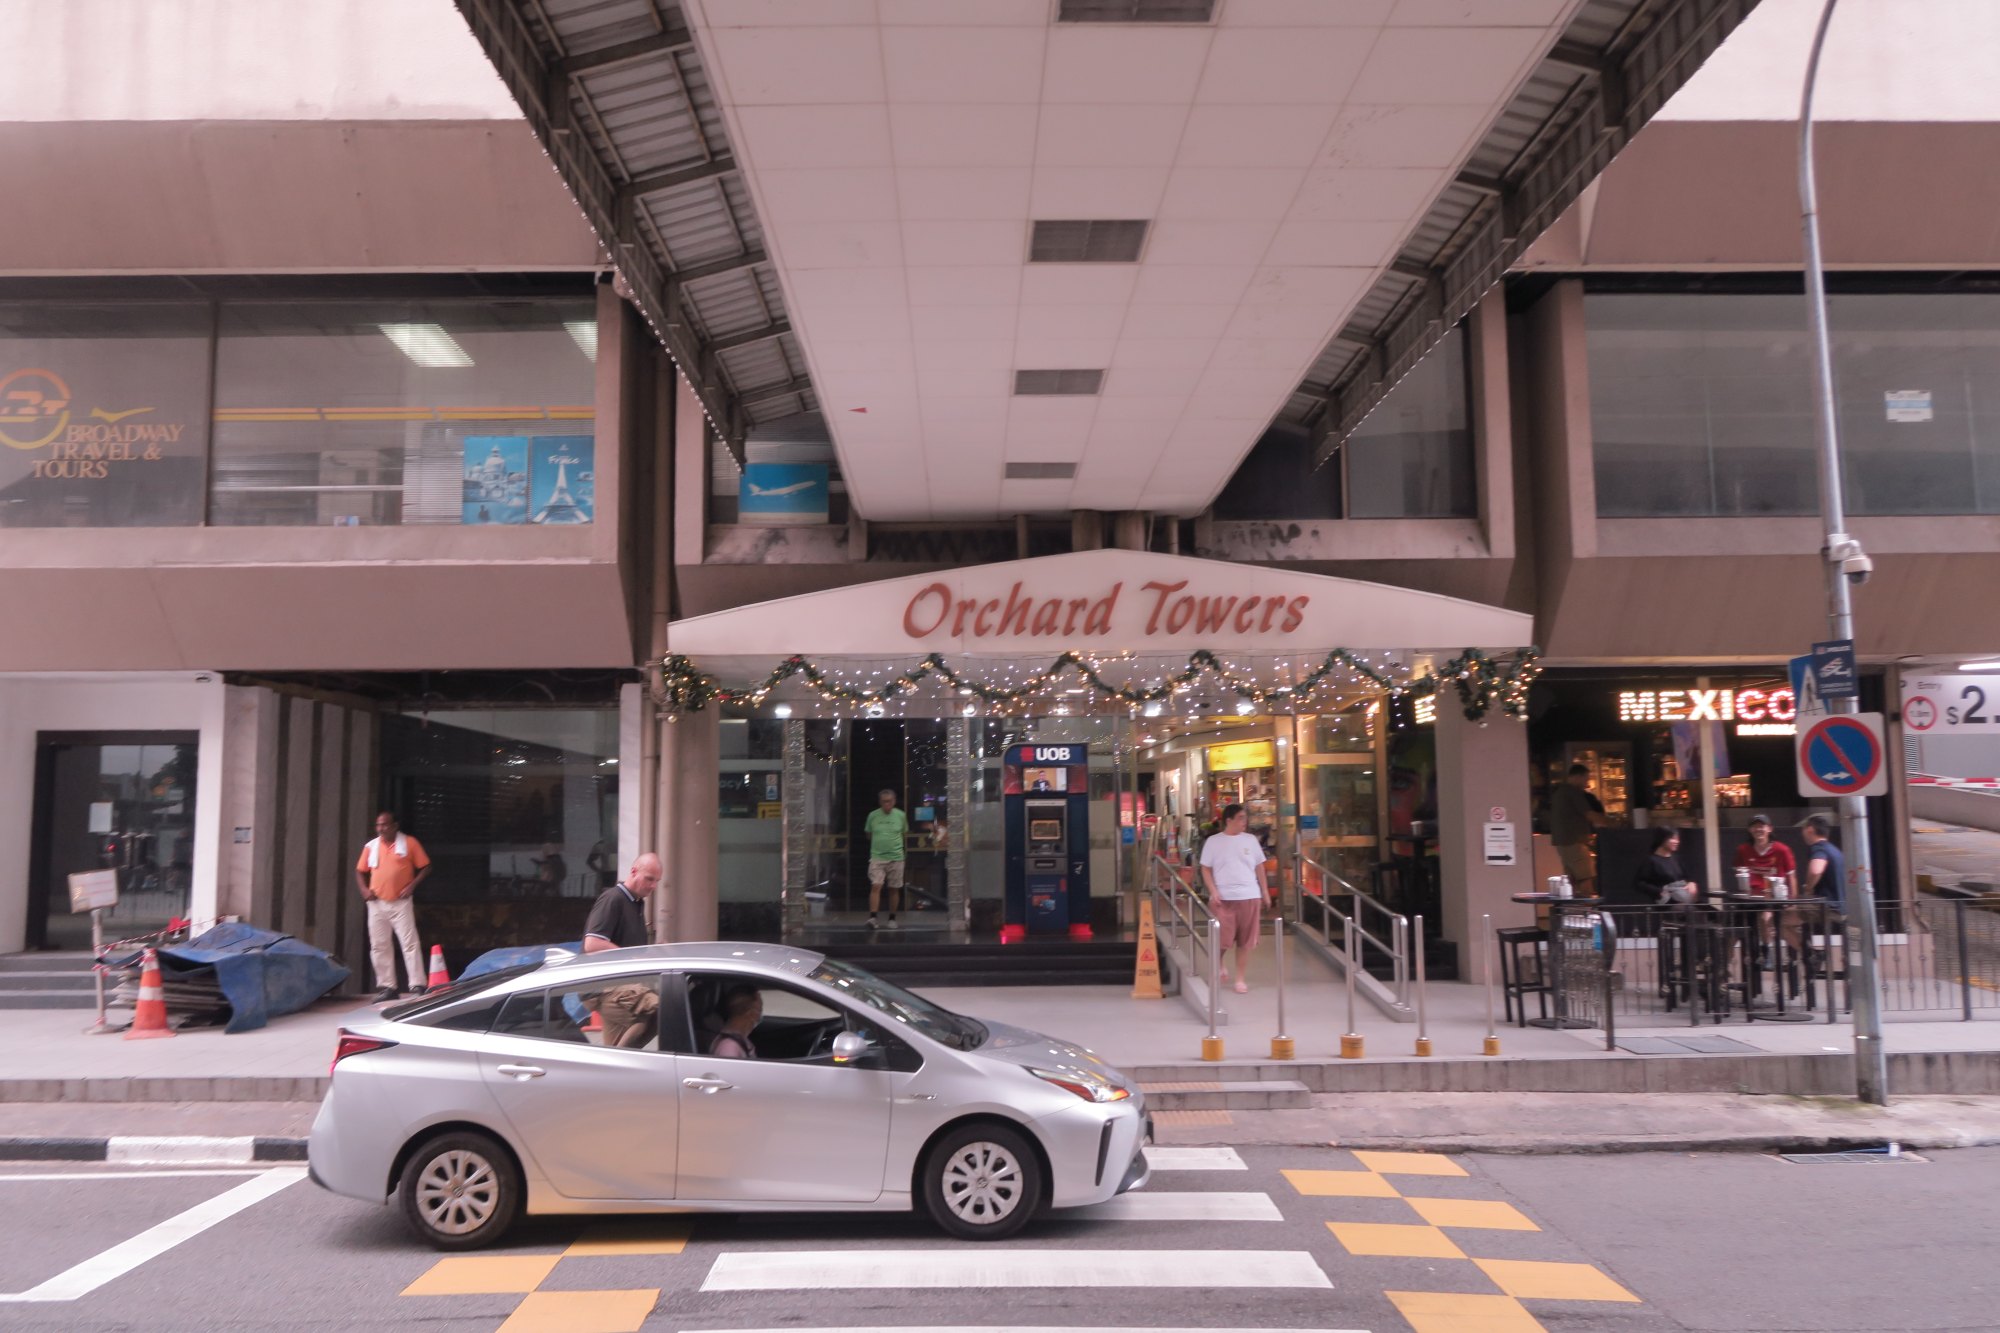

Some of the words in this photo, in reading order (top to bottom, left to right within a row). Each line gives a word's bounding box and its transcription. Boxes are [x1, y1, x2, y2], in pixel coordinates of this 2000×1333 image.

[66, 424, 185, 442] BROADWAY
[51, 442, 138, 461] TRAVEL
[143, 443, 162, 461] &
[31, 460, 109, 479] TOURS
[902, 581, 1123, 639] Orchard
[1140, 580, 1310, 636] Towers
[1619, 690, 1796, 721] MEXICO
[1035, 747, 1071, 761] UOB
